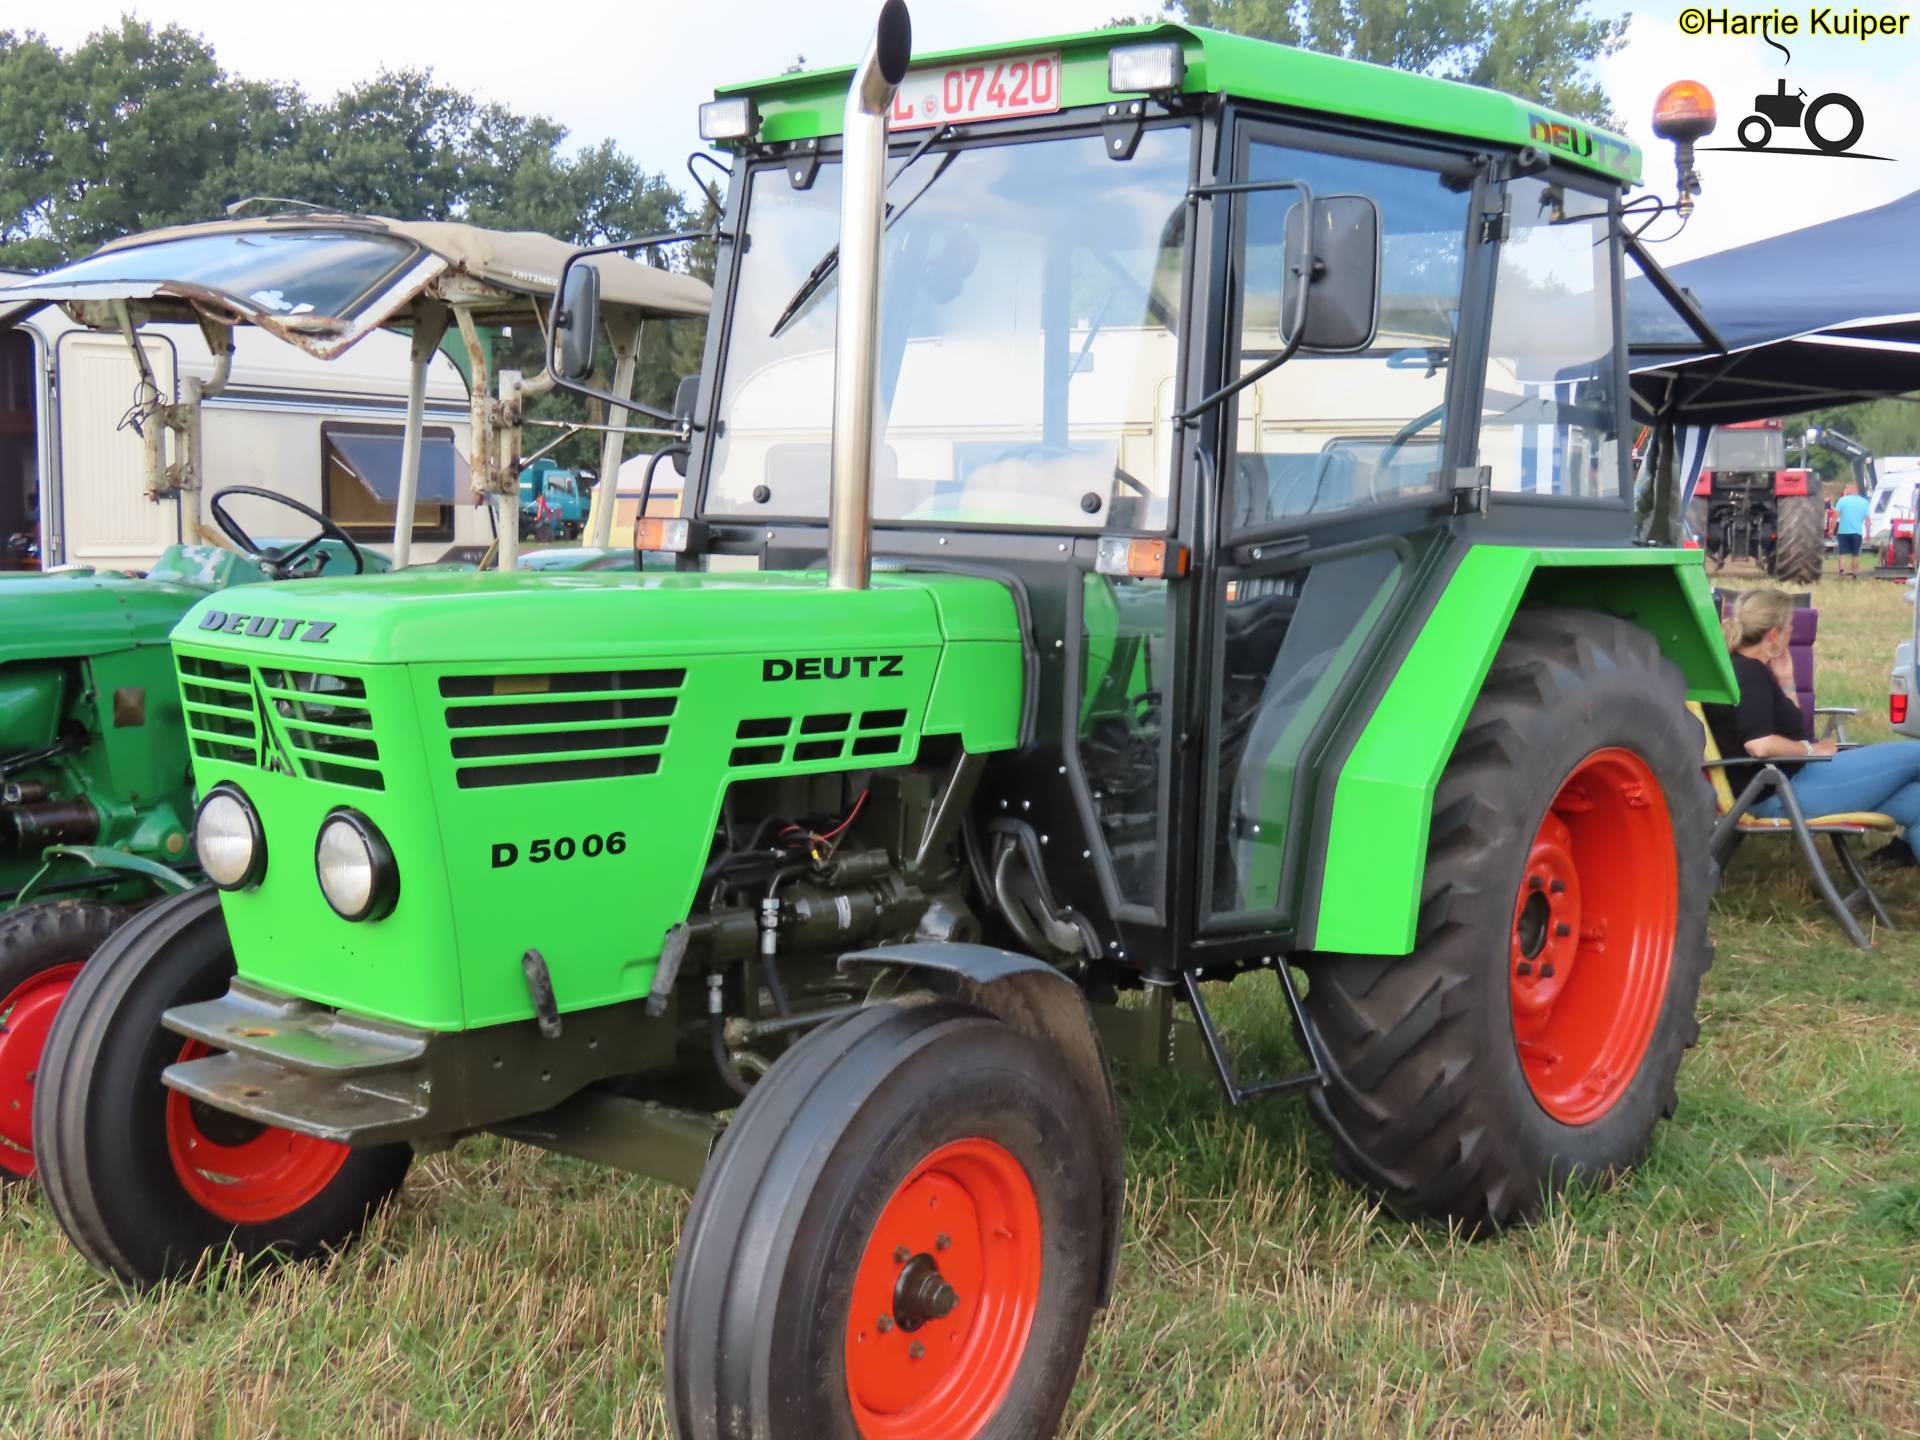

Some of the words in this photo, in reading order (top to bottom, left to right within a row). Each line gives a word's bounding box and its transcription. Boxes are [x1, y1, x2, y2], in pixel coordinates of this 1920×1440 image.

[943, 58, 1052, 114] 07420
[1528, 112, 1632, 170] DEUTZ
[198, 609, 337, 643] DEUTZ
[762, 655, 904, 682] DEUTZ
[491, 842, 519, 869] D
[528, 831, 626, 863] 5006
